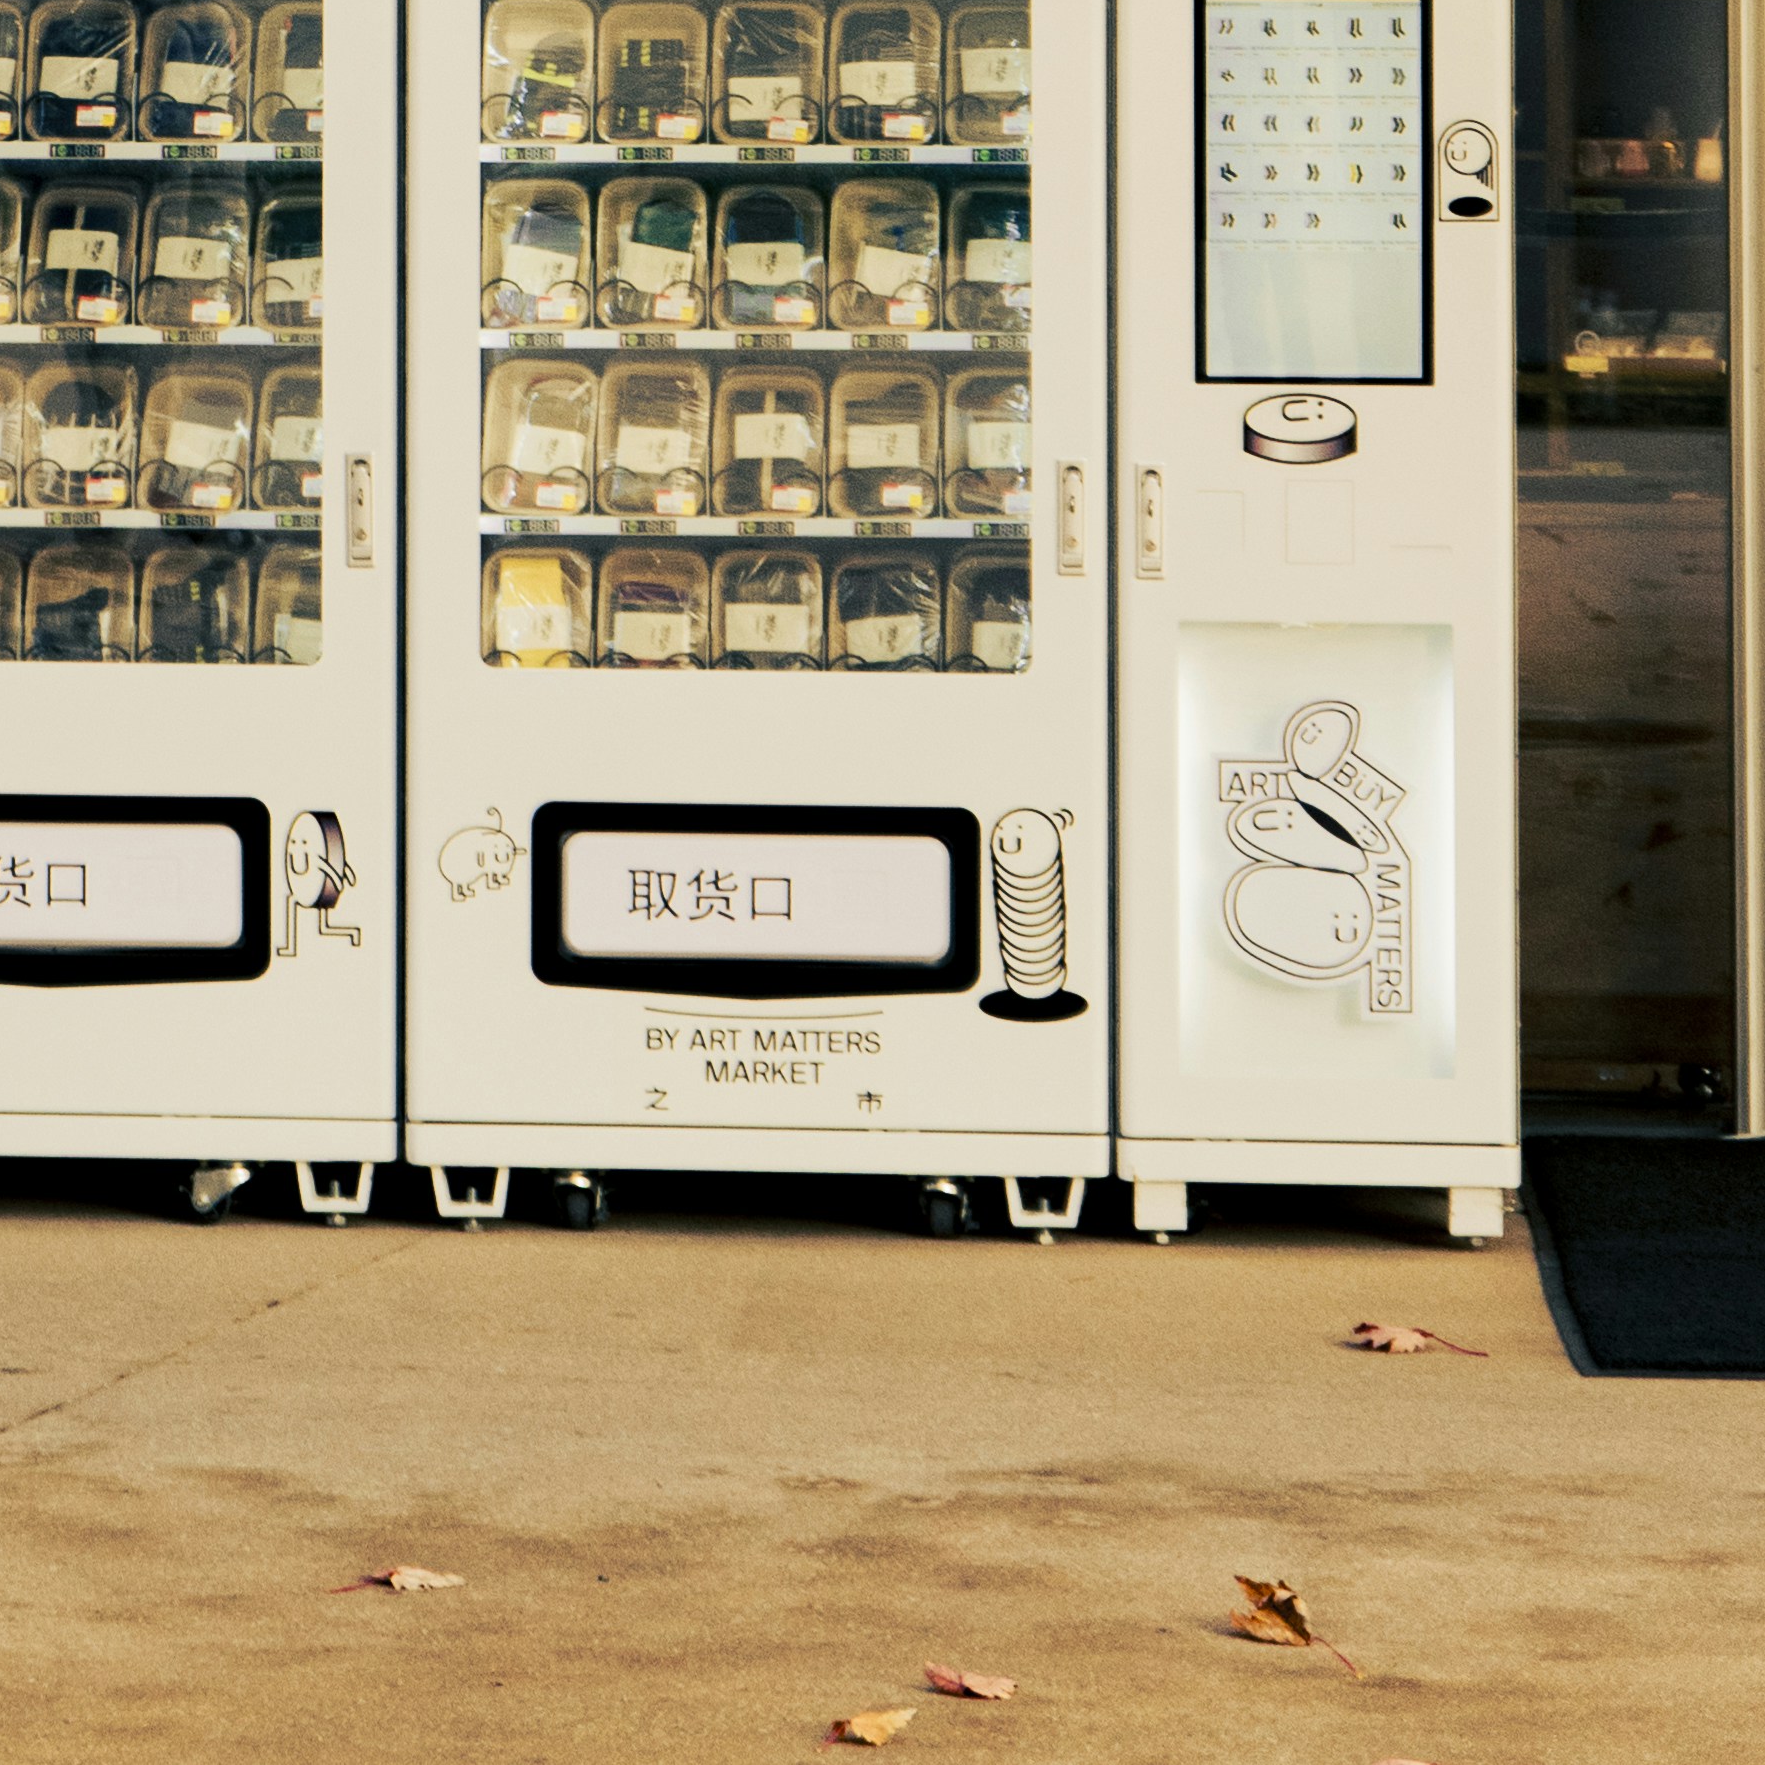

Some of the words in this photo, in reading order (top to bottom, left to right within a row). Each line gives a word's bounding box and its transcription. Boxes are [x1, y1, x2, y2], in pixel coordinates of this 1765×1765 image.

[1226, 771, 1288, 799] ART
[627, 868, 793, 921] 取货口
[1375, 862, 1403, 1009] MATTERS
[644, 1027, 680, 1051] BY
[689, 1028, 743, 1052] ART
[752, 1029, 883, 1055] MATTERS
[705, 1059, 826, 1085] MARKET
